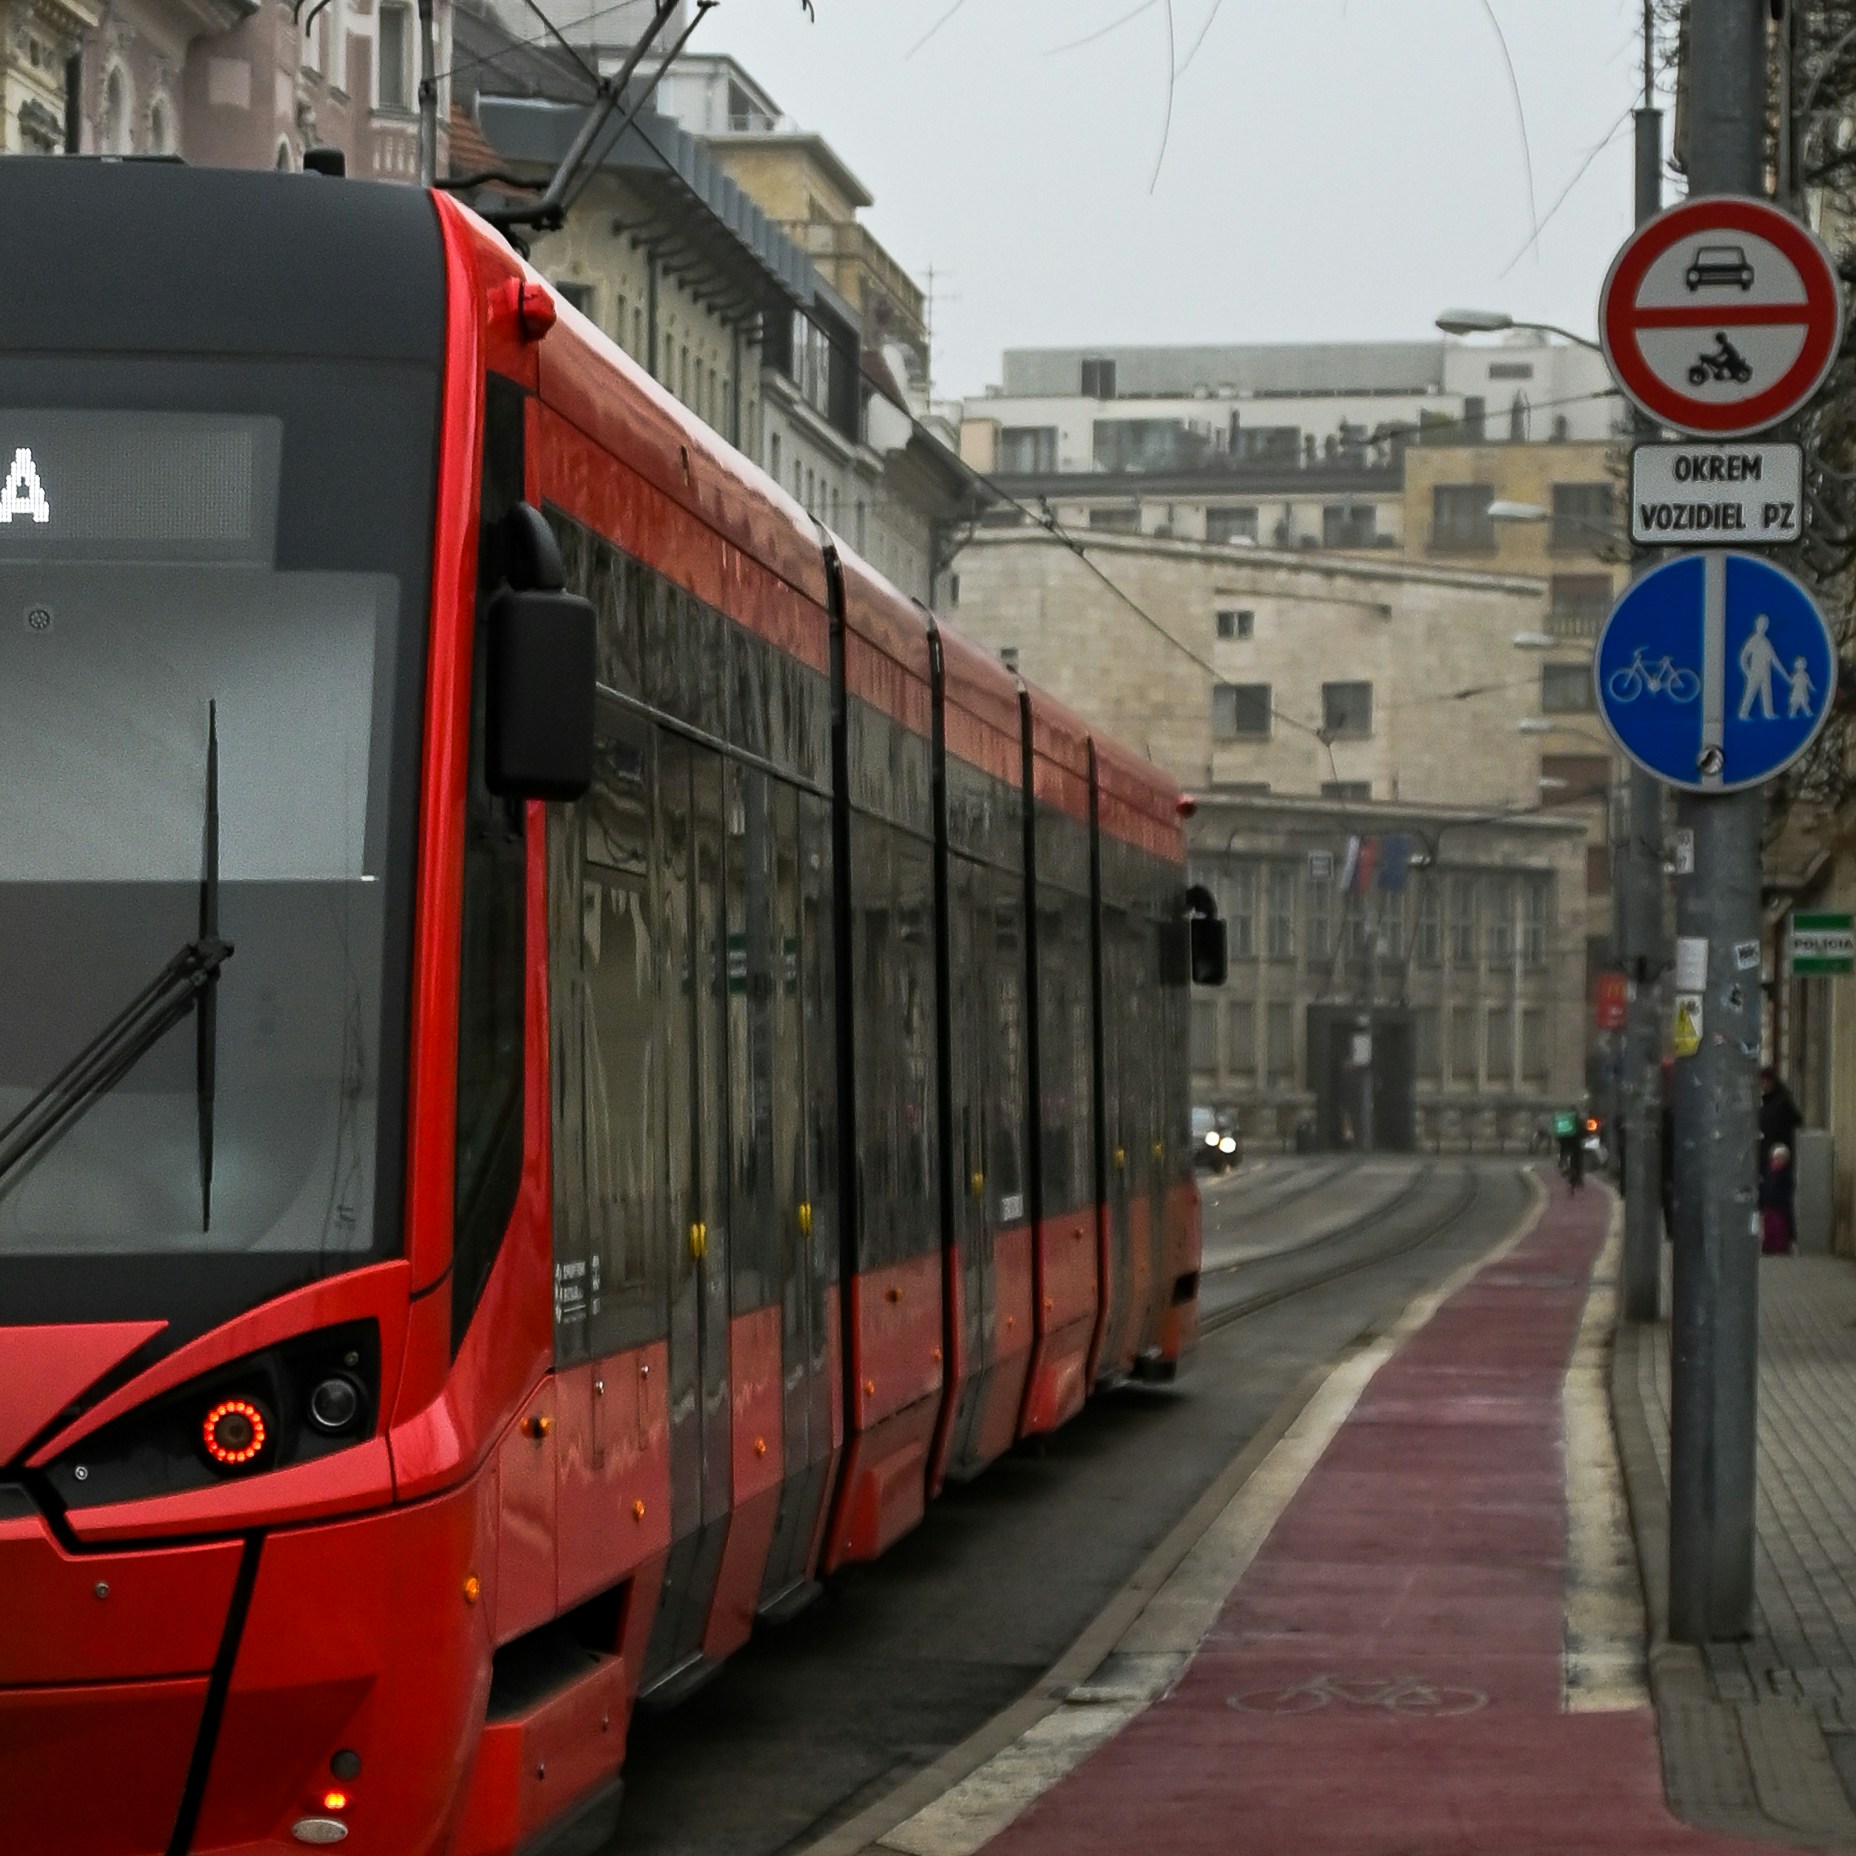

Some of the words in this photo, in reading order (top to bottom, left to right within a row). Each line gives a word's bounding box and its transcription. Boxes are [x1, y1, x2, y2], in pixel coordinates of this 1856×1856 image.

[1674, 454, 1763, 482] OKREM
[1640, 502, 1746, 531] VOZIDIEL
[1762, 502, 1796, 530] PZ
